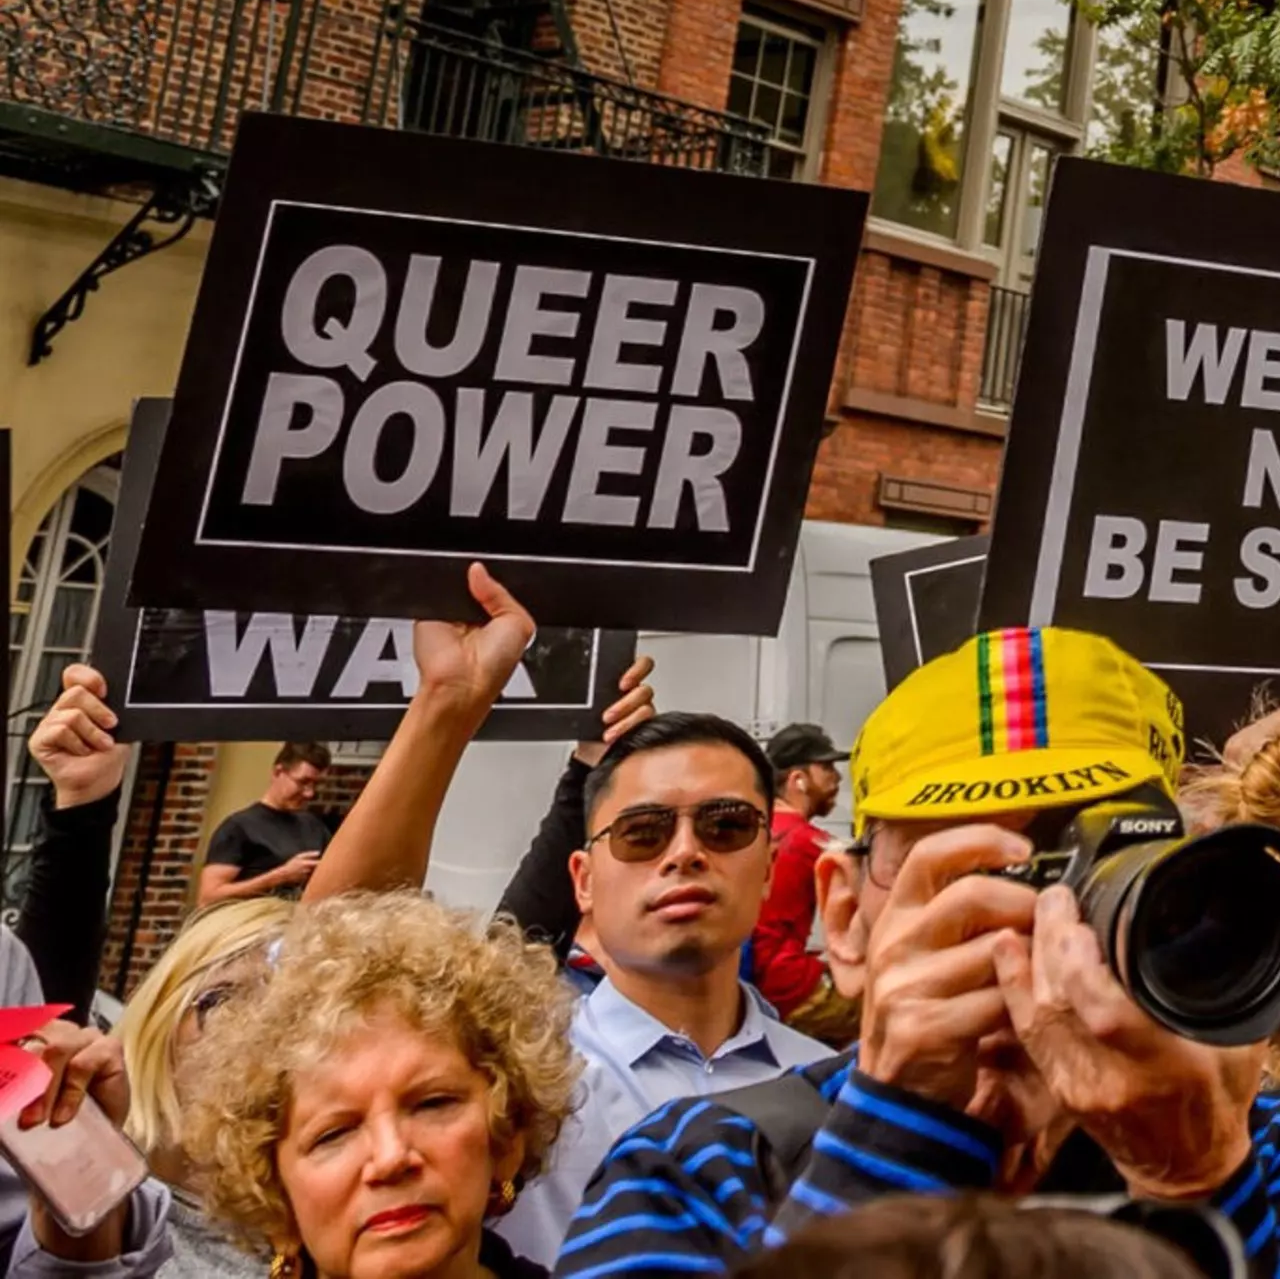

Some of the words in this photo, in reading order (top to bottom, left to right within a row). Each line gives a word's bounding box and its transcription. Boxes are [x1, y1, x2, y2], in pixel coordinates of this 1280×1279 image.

[281, 244, 766, 401] QUEER
[240, 372, 743, 533] POWER
[1083, 515, 1209, 604] BE
[906, 761, 1132, 807] BROOKLYN
[1119, 819, 1176, 834] SONY
